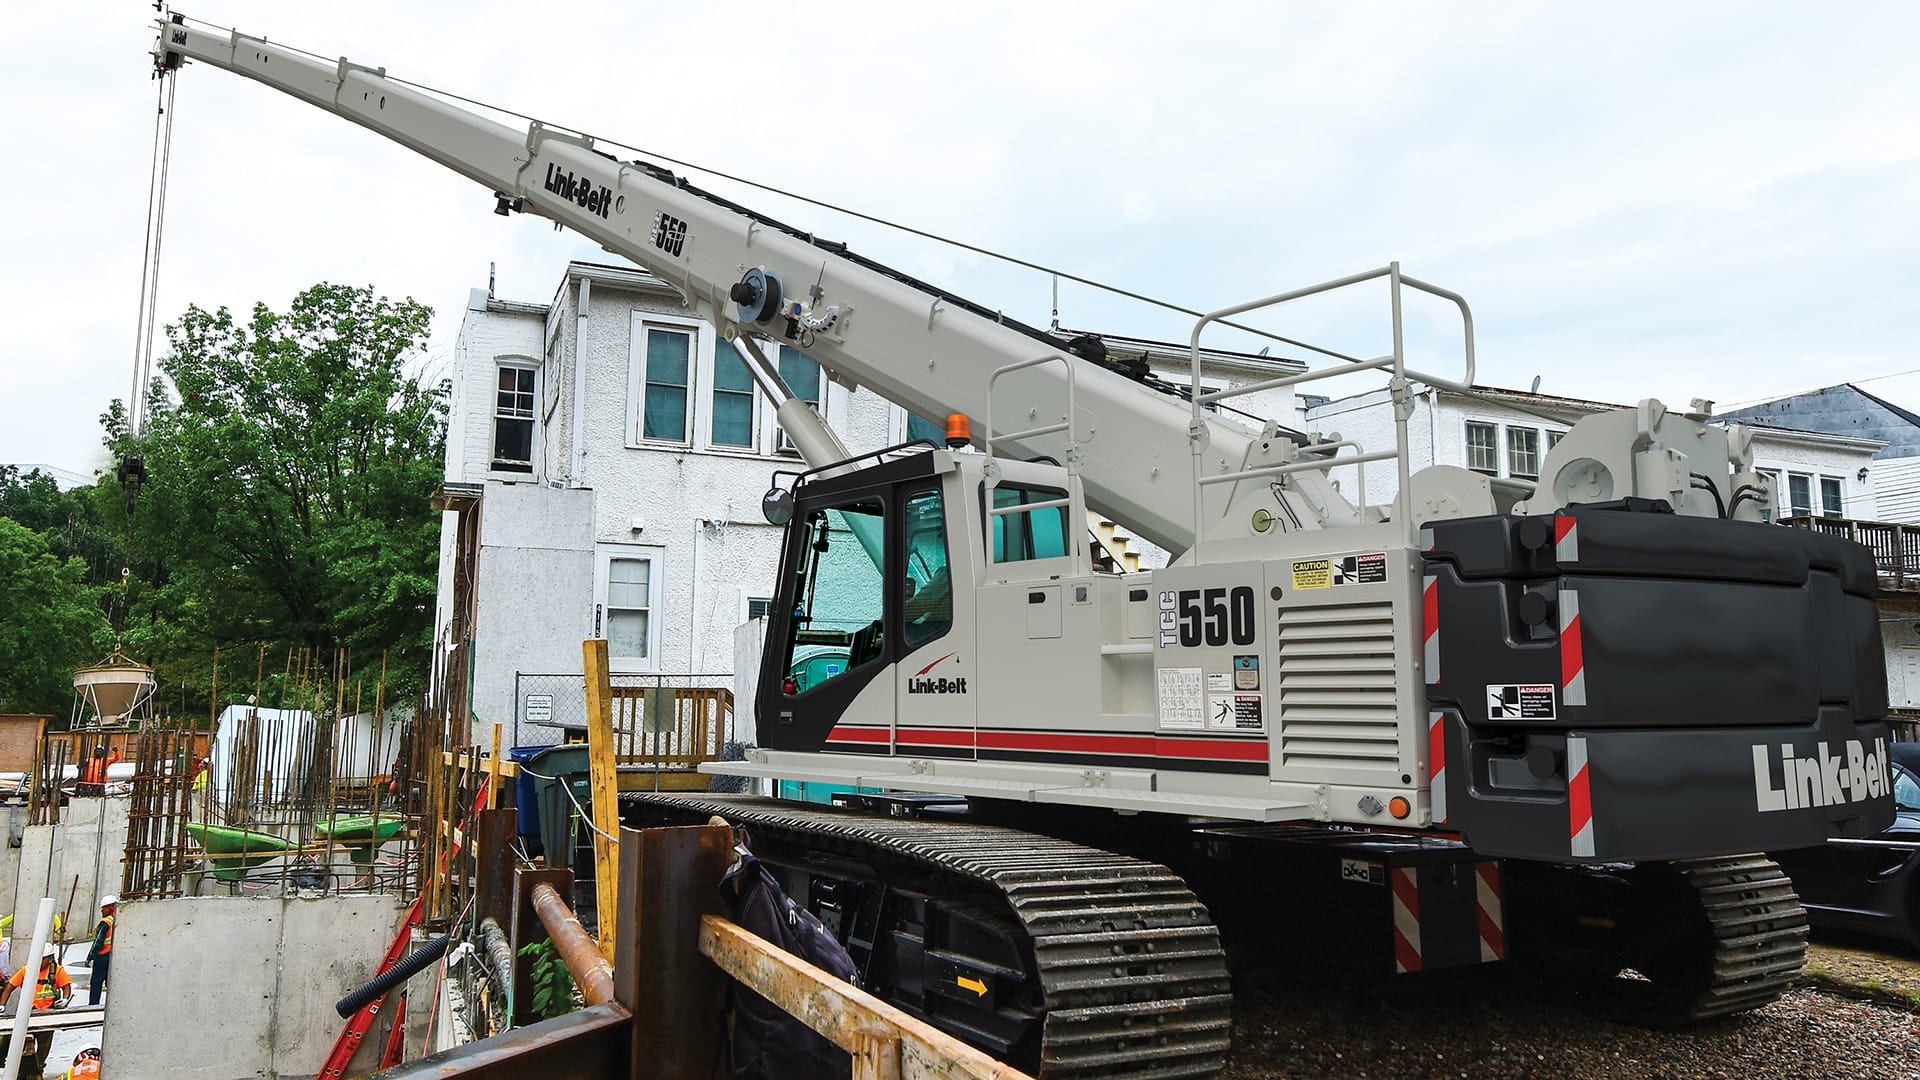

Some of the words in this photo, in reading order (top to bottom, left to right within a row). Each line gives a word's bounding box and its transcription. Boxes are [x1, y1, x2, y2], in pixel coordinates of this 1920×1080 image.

[544, 162, 611, 219] Link-Belt
[656, 213, 687, 257] 550
[1293, 561, 1328, 571] CAUTION
[1159, 591, 1177, 648] TCC
[1179, 586, 1255, 647] 550
[908, 678, 967, 694] Link-Belt
[1752, 737, 1890, 812] Link-Belt
